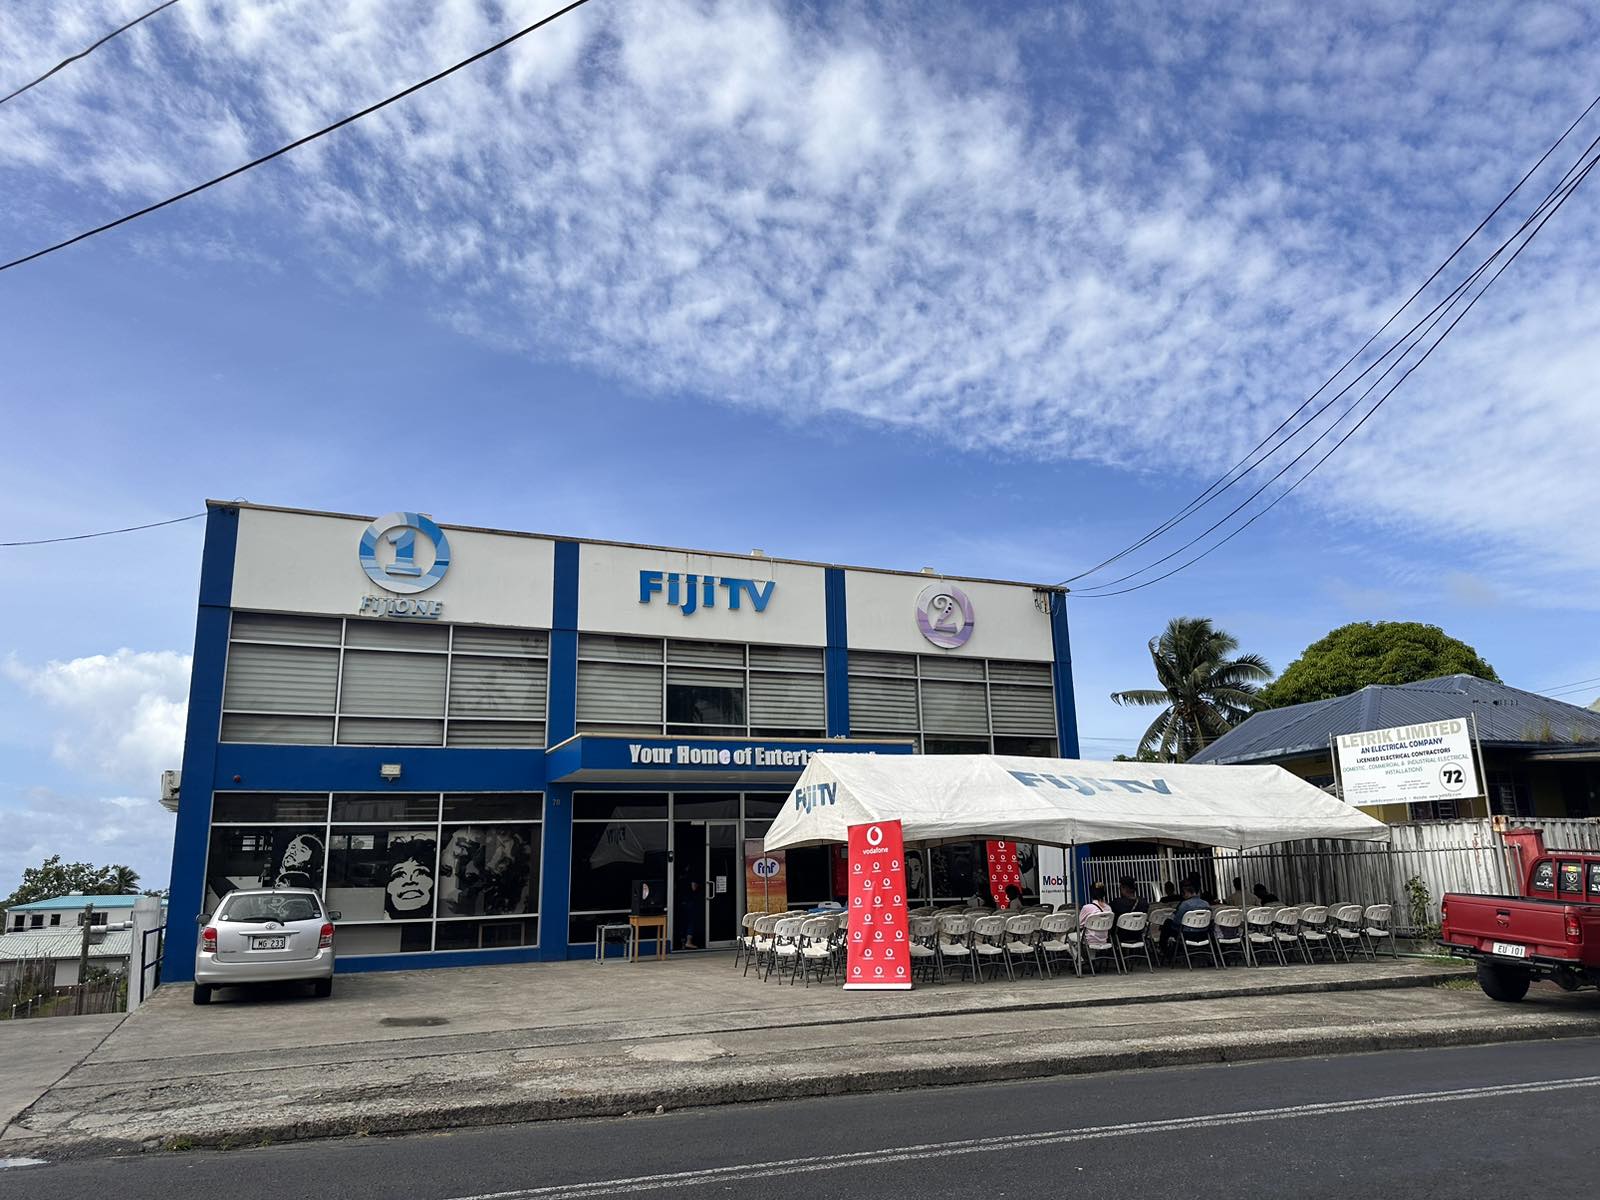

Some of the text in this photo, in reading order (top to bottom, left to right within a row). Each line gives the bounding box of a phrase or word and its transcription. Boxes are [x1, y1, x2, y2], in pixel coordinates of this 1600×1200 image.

[1342, 720, 1462, 748] LETRIK LIMITED
[1371, 742, 1408, 753] ELECTRICAL
[1409, 737, 1443, 748] COMPANY
[629, 744, 673, 764] Your
[676, 745, 731, 765] Home
[733, 747, 752, 765] of
[1380, 752, 1411, 761] ELECTRICAL
[1411, 747, 1451, 757] CONTRACTORS
[1437, 753, 1469, 762] ELECTRICAL
[1443, 769, 1463, 784] 72
[862, 847, 889, 855] vodafone
[1498, 945, 1523, 956] EU 101
